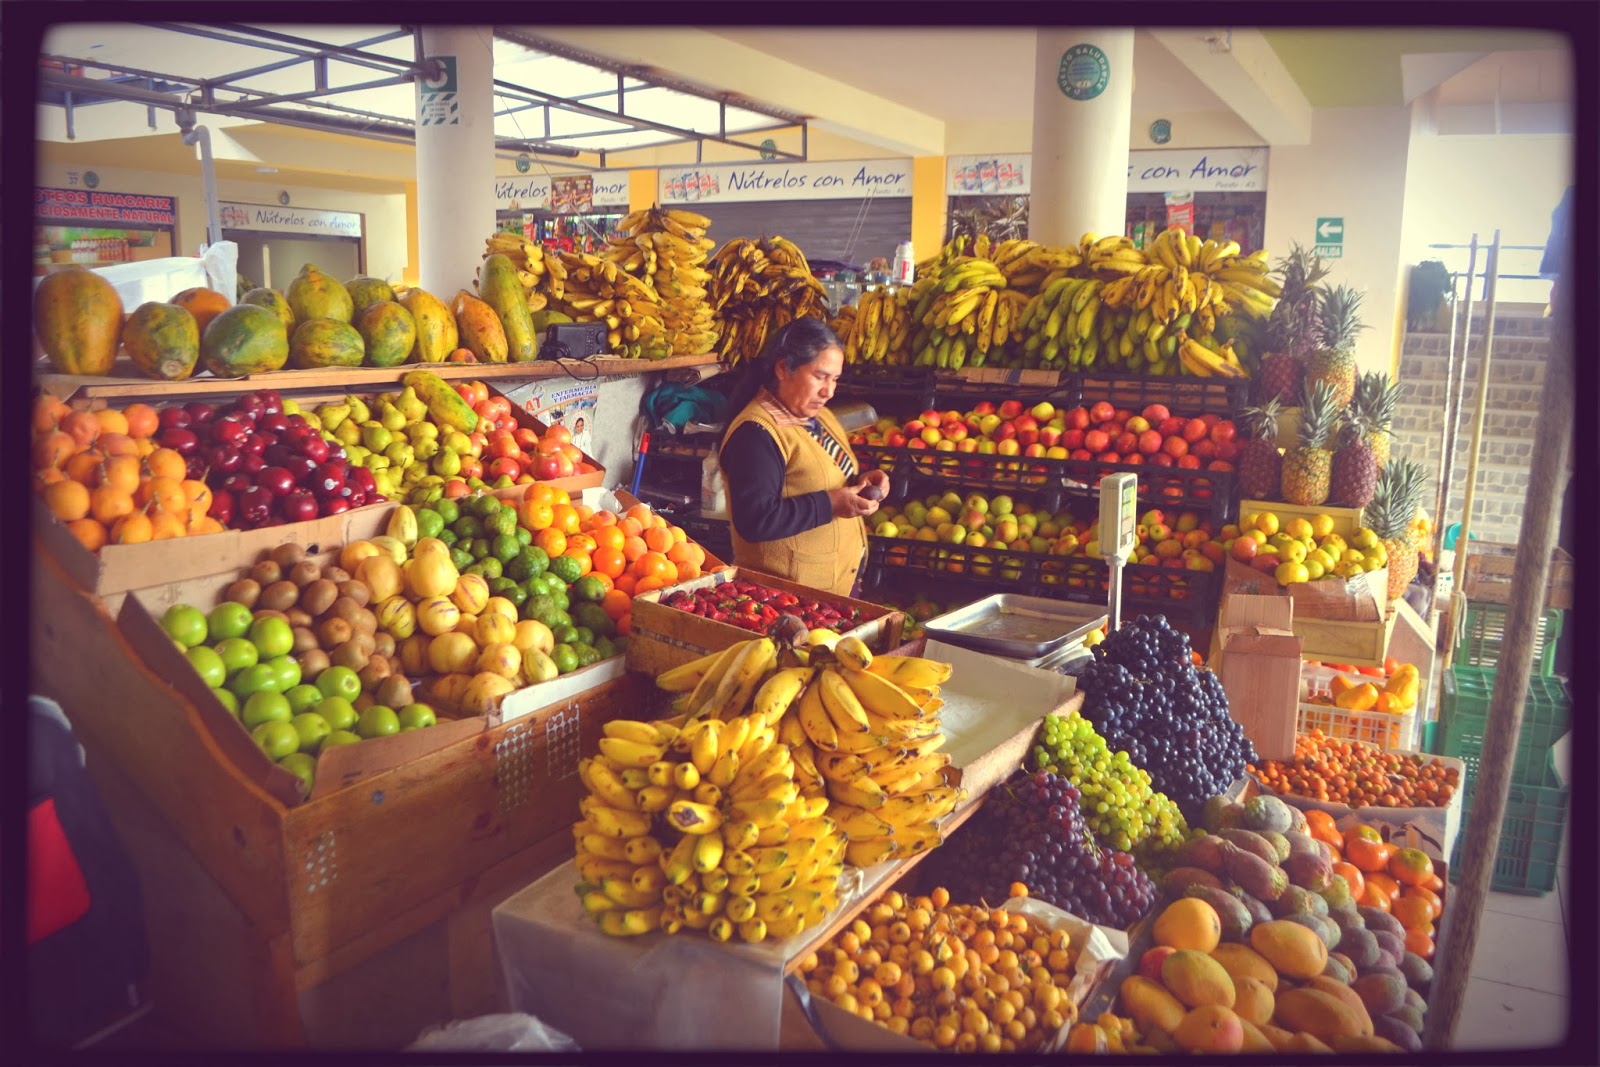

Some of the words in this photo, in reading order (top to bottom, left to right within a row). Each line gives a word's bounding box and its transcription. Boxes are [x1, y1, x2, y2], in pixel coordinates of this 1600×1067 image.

[1060, 54, 1073, 92] PUESTO
[1075, 48, 1107, 89] SALUDABLE
[1141, 165, 1180, 180] con
[1189, 156, 1257, 179] Amor
[495, 181, 548, 199] útrelos
[592, 178, 627, 195] mor
[727, 169, 807, 192] Nútrelos
[812, 175, 844, 188] con
[851, 166, 906, 187] Amor
[92, 194, 170, 209] HUACARIZ
[123, 209, 174, 223] NATURAL
[255, 210, 305, 226] Nútrelos
[308, 218, 328, 227] con
[329, 216, 357, 229] Amor
[1315, 246, 1341, 257] SALIDA
[559, 390, 593, 402] FARMACIA
